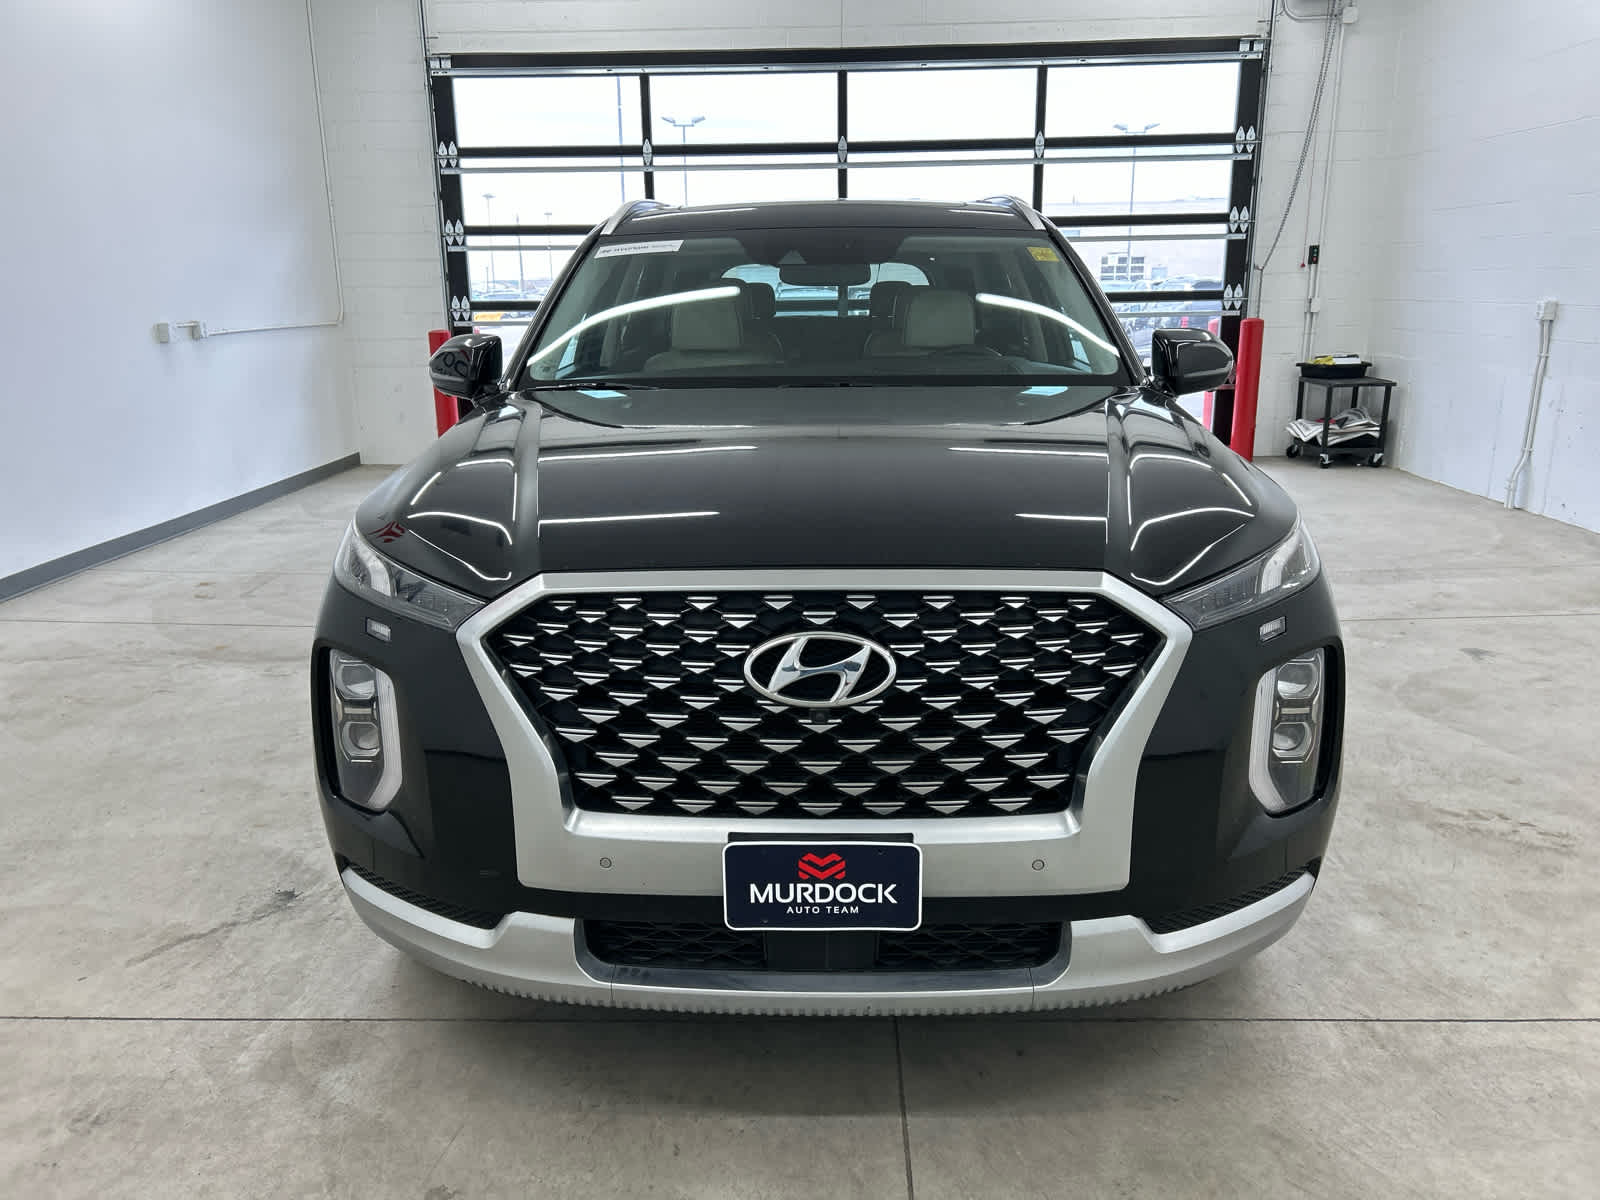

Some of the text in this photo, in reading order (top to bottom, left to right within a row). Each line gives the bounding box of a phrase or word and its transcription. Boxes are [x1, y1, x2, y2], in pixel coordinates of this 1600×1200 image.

[750, 883, 898, 904] MURDOCK
[786, 906, 859, 914] AUTO TEAM
